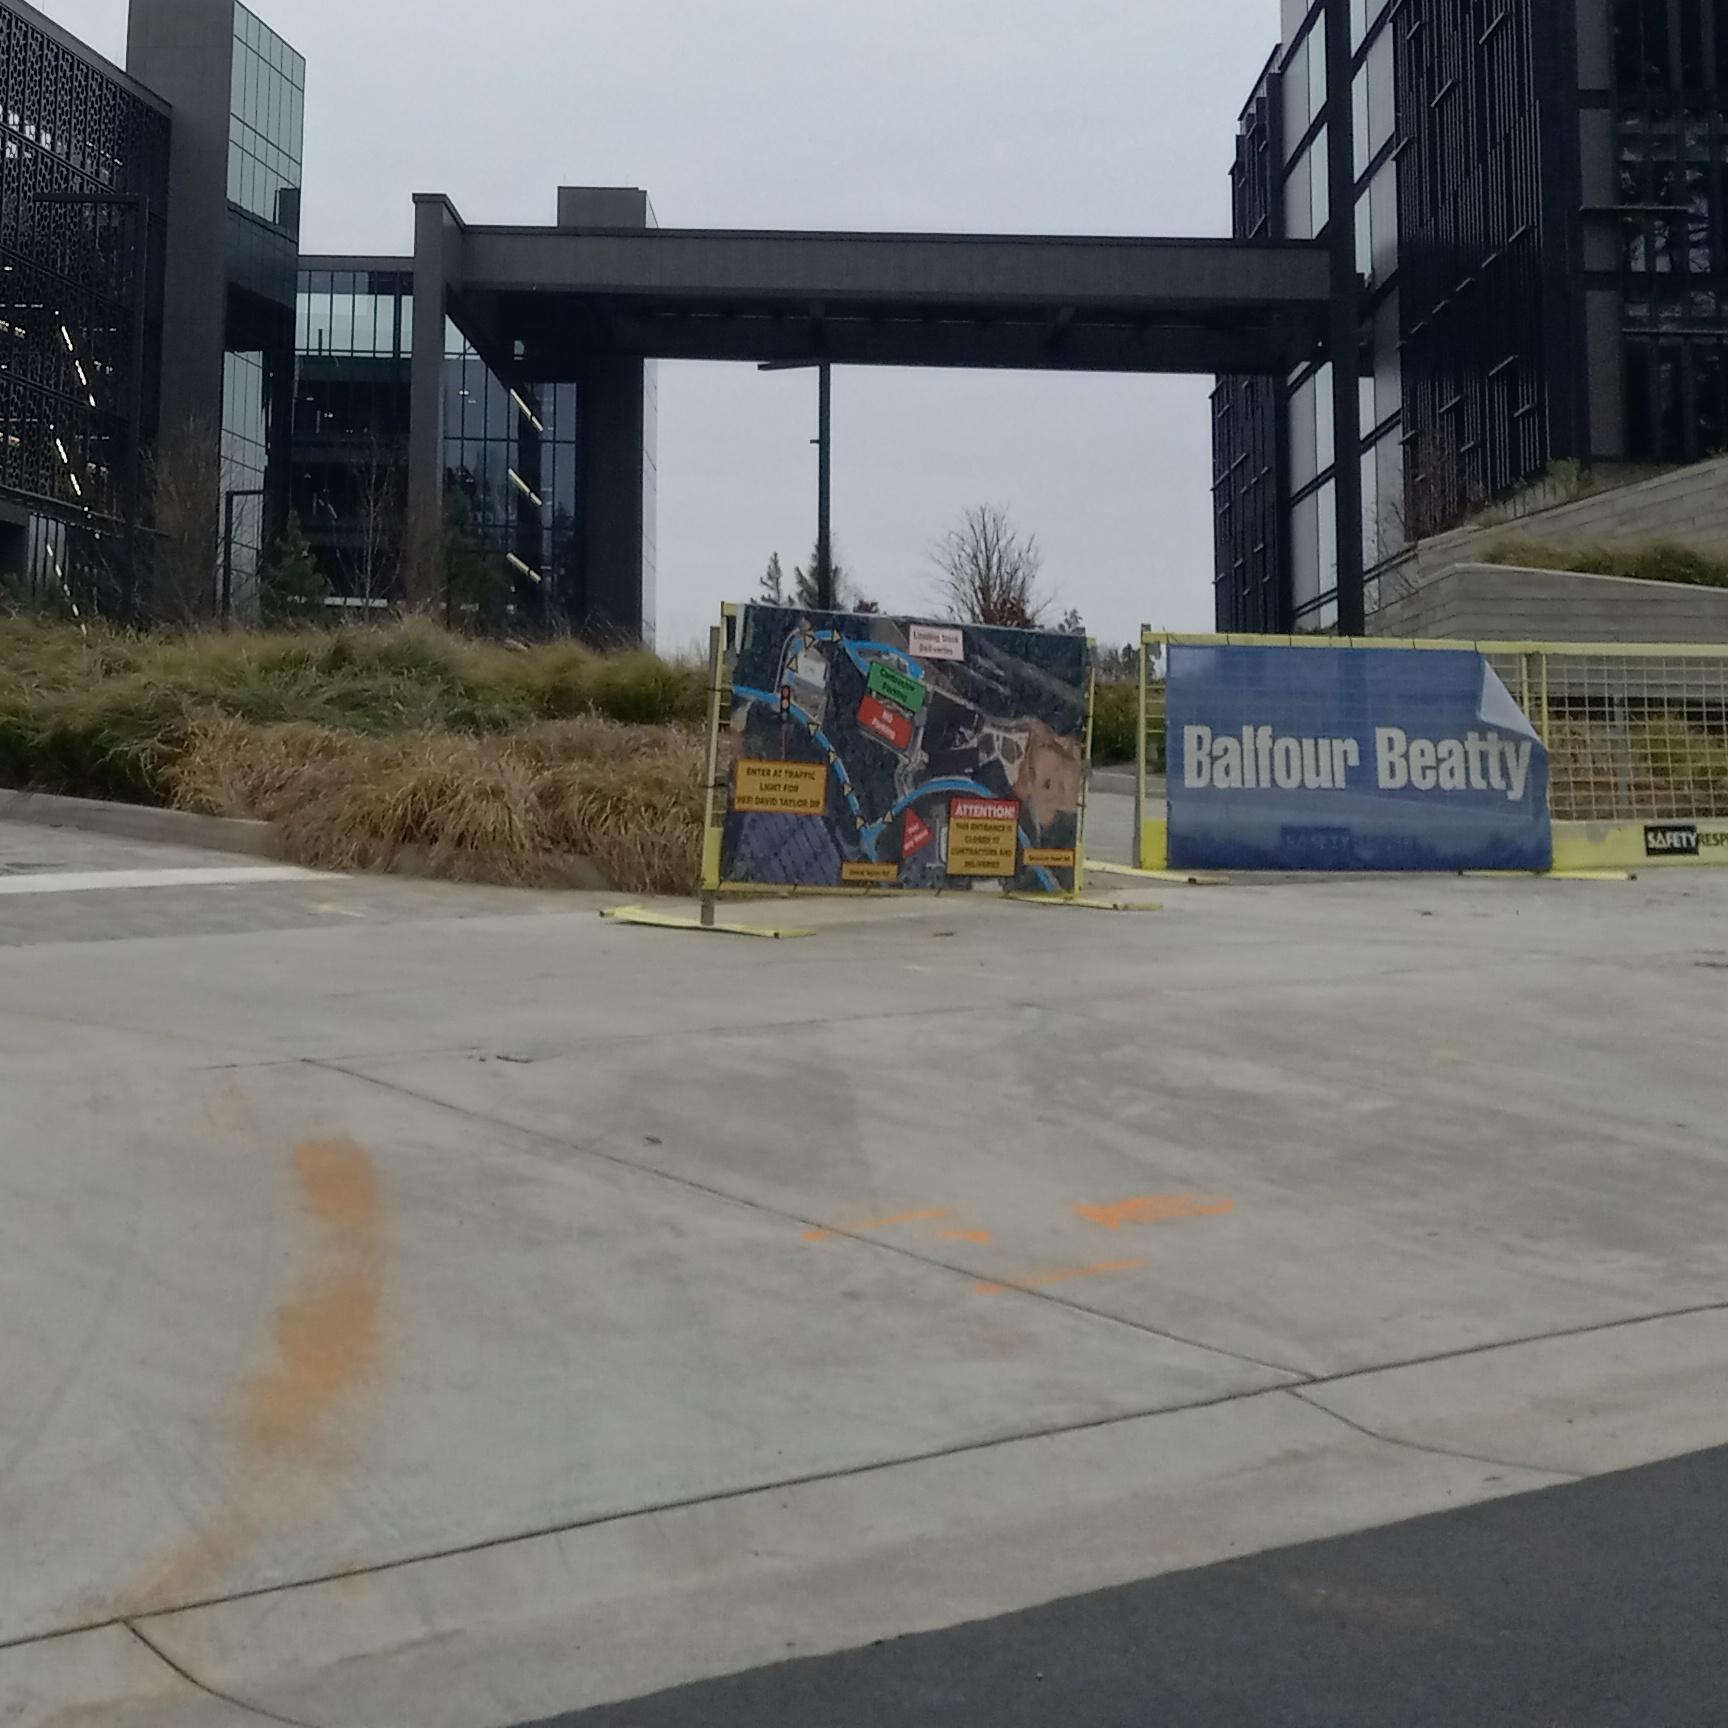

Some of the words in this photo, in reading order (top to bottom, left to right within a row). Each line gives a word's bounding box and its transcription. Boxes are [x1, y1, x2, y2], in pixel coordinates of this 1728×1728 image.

[1183, 724, 1360, 790] Balfour
[1375, 725, 1533, 801] Beatty
[746, 767, 771, 778] ENTER
[784, 769, 816, 781] TRAFFIC
[754, 796, 777, 807] DAVID
[954, 802, 1016, 818] ATTENTION!
[1647, 830, 1698, 849] SAFETY
